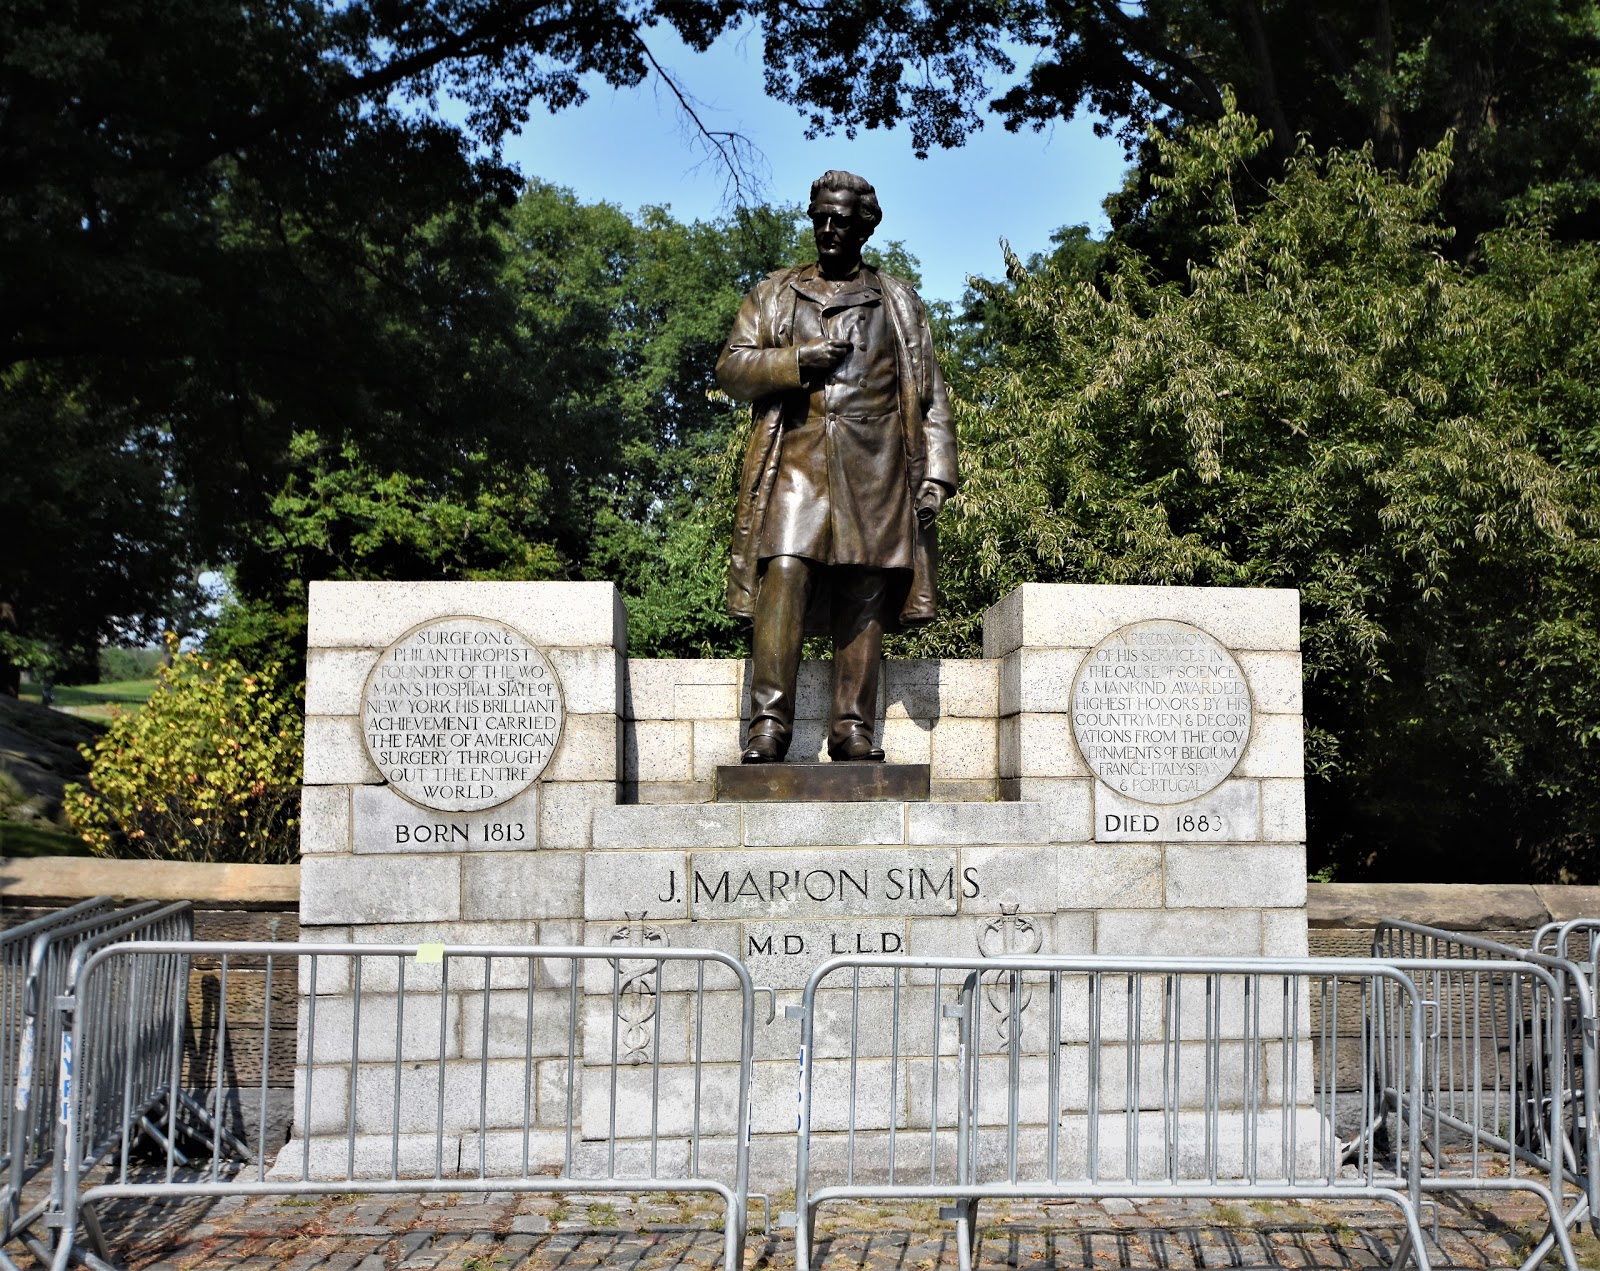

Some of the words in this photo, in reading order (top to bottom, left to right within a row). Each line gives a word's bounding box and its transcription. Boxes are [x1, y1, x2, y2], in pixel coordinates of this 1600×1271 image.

[417, 632, 500, 646] SURGEON
[394, 648, 532, 662] PHILANTHROPIST
[1097, 649, 1115, 662] OF
[1117, 649, 1138, 662] HIS
[1141, 649, 1205, 662] SERVICES
[1210, 649, 1223, 662] IN
[381, 665, 456, 679] FOUNDER
[458, 665, 479, 679] OF
[483, 665, 514, 679] THE
[1089, 665, 1114, 678] THE
[1114, 665, 1159, 678] CAUSE
[1177, 665, 1237, 678] SCIENCE
[425, 682, 495, 697] HOSPITAL
[498, 682, 536, 697] STATE
[1094, 681, 1166, 694] MANKIND
[1171, 681, 1245, 694] AWARDED
[366, 699, 402, 714] NEW
[408, 699, 451, 714] YORK
[455, 699, 479, 714] HIS
[483, 699, 559, 714] BRILLIANT
[1075, 697, 1132, 711] HIGHEST
[1138, 697, 1199, 711] HONORS
[1204, 697, 1221, 711] BY
[1227, 697, 1248, 711] HIS
[368, 716, 482, 731] ACHIEVEMENT
[486, 716, 556, 731] CARRIED
[1075, 713, 1181, 727] COUNTRYMEN
[1185, 713, 1194, 727] &
[369, 733, 401, 748] THE
[405, 733, 446, 748] FAME
[450, 733, 472, 748] OF
[474, 733, 554, 748] AMERICAN
[1080, 730, 1132, 743] ATIONS
[1135, 730, 1176, 743] FROM
[1181, 730, 1209, 743] THE
[379, 750, 452, 765] SURGERY
[1088, 746, 1162, 759] ERNMENTS
[1182, 746, 1237, 759] BELGIUM
[390, 768, 427, 782] OUT
[432, 768, 466, 782] THE
[471, 768, 531, 782] ENTIRE
[423, 785, 497, 799] WORLD.
[1132, 778, 1204, 792] PORTUGAL
[1105, 815, 1160, 832] DIED
[1177, 815, 1223, 832] 1883
[395, 824, 469, 843] BORN
[483, 824, 525, 843] 1813
[658, 869, 681, 903] J.
[694, 869, 868, 904] MARION
[885, 867, 980, 901] SIMS
